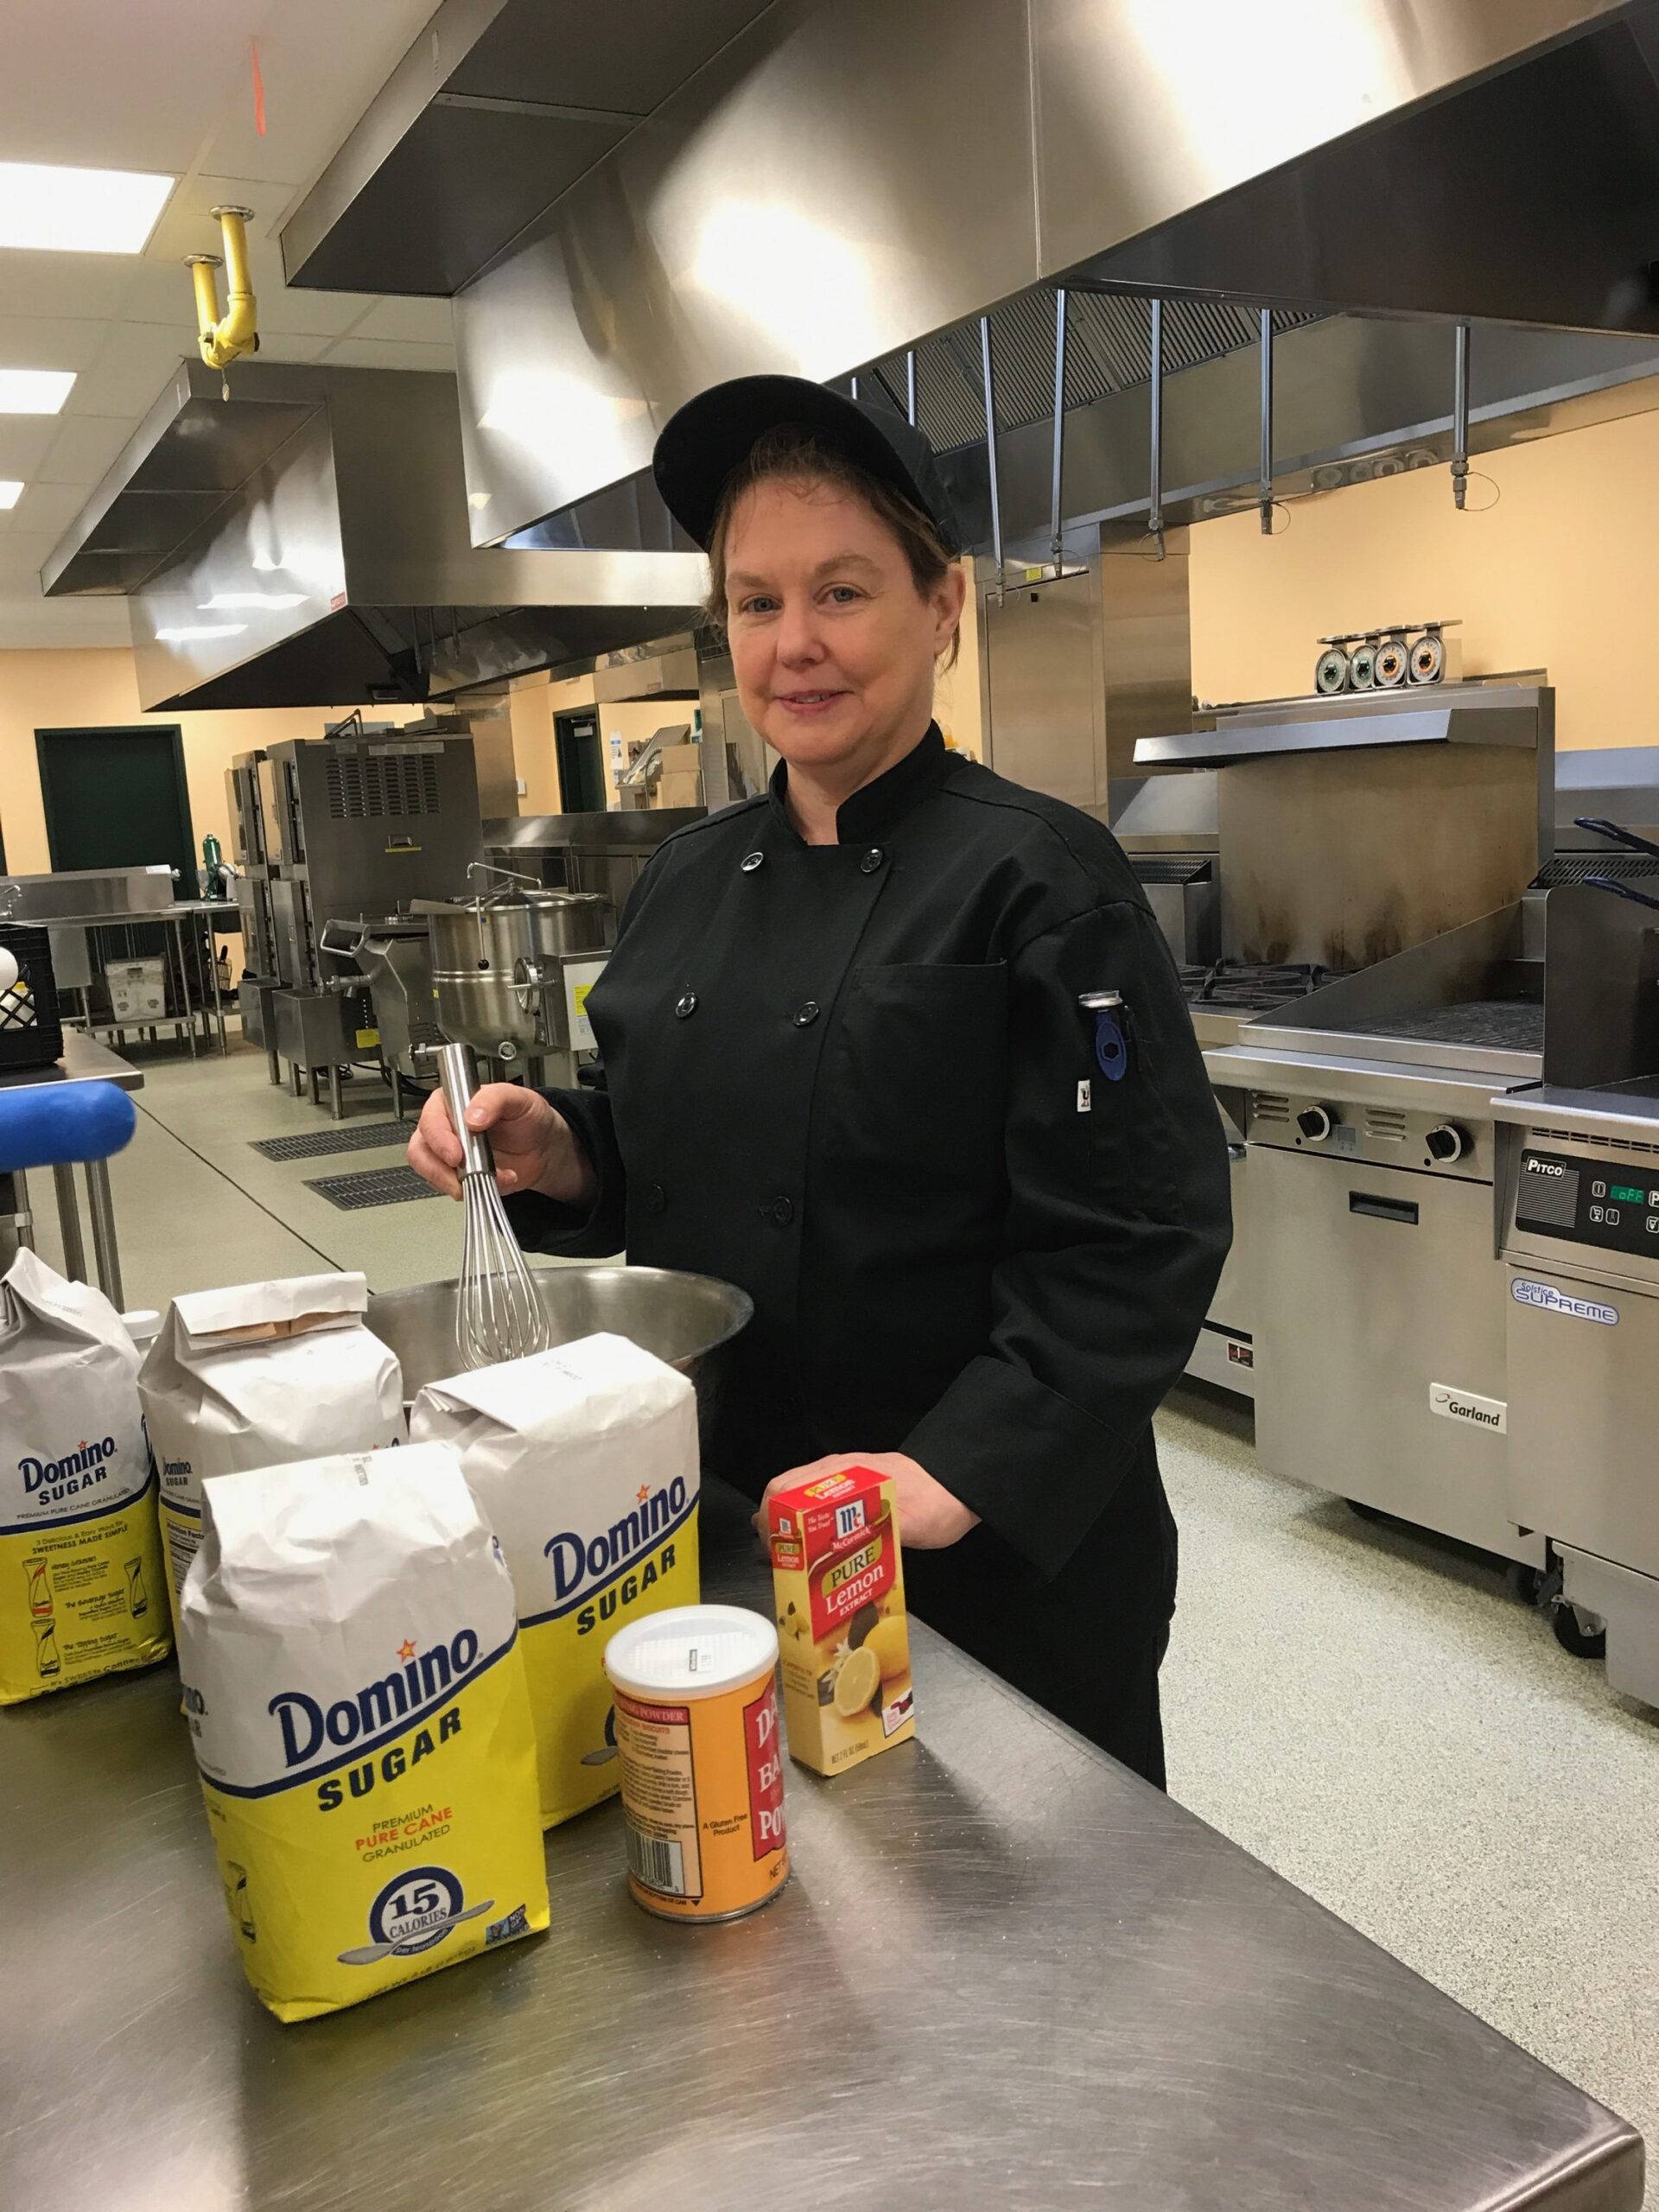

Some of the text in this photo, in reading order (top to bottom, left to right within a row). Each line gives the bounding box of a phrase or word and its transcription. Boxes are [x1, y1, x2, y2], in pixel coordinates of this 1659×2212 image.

[1528, 1159, 1563, 1176] PITCO
[1521, 1282, 1554, 1297] Solstice
[1516, 1288, 1614, 1322] SUPREME
[1449, 1402, 1500, 1427] Garland
[18, 1436, 116, 1493] Domino
[39, 1466, 107, 1506] SUGAR
[166, 1477, 188, 1486] SUGAR
[816, 1479, 855, 1500] Lemon
[50, 1506, 67, 1516] PURE
[69, 1502, 90, 1511] CANE
[32, 1524, 128, 1554] SWEETNESS MADE SIMPLE
[543, 1476, 686, 1602] Domino
[831, 1526, 872, 1551] McCormick
[778, 1554, 799, 1564] Lemon
[831, 1546, 877, 1587] PURE
[576, 1544, 676, 1636] SUGAR
[825, 1565, 885, 1615] Lemon
[839, 1588, 874, 1617] EXTRACT
[268, 1628, 479, 1769] Domino
[640, 1708, 683, 1721] POWDER
[317, 1707, 462, 1812] SUGAR
[355, 1807, 453, 1851] PURE CANE
[372, 1803, 433, 1833] PREMIUM
[709, 1819, 733, 1829] Gluten
[733, 1814, 748, 1824] Free
[713, 1825, 740, 1837] Product
[362, 1824, 450, 1862] GRANULATED
[389, 1882, 440, 1920] 15
[390, 1907, 448, 1939] CALORIES
